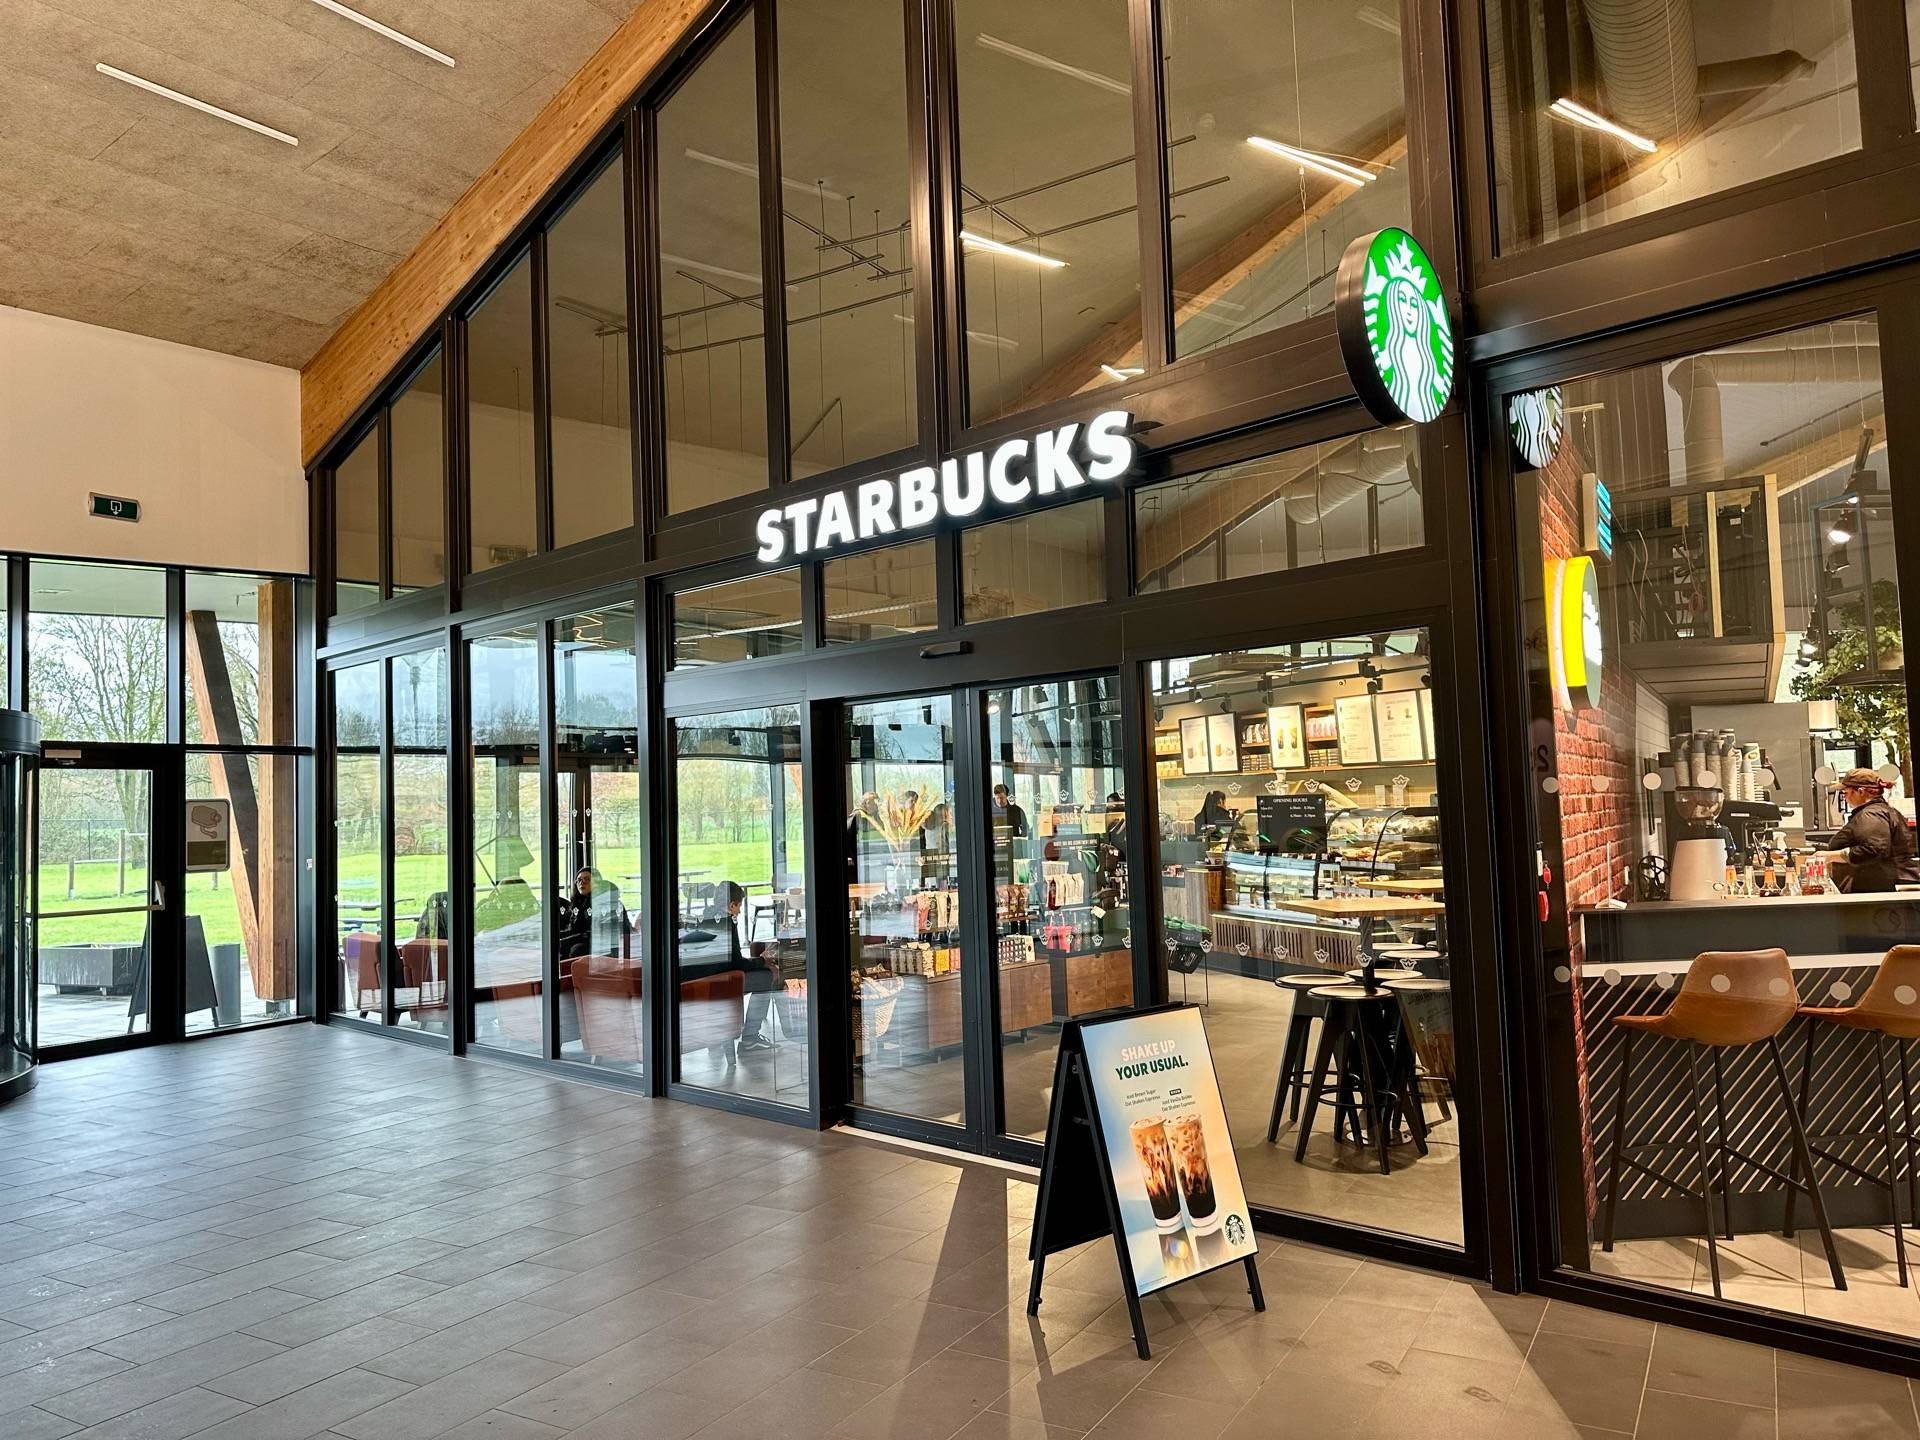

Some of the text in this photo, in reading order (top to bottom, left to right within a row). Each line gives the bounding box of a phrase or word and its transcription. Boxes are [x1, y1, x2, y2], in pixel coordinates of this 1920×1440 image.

[756, 410, 1132, 563] STARBUCKS
[1121, 1039, 1176, 1062] SHAKE UP
[1115, 1055, 1189, 1080] YOUR USUAL.
